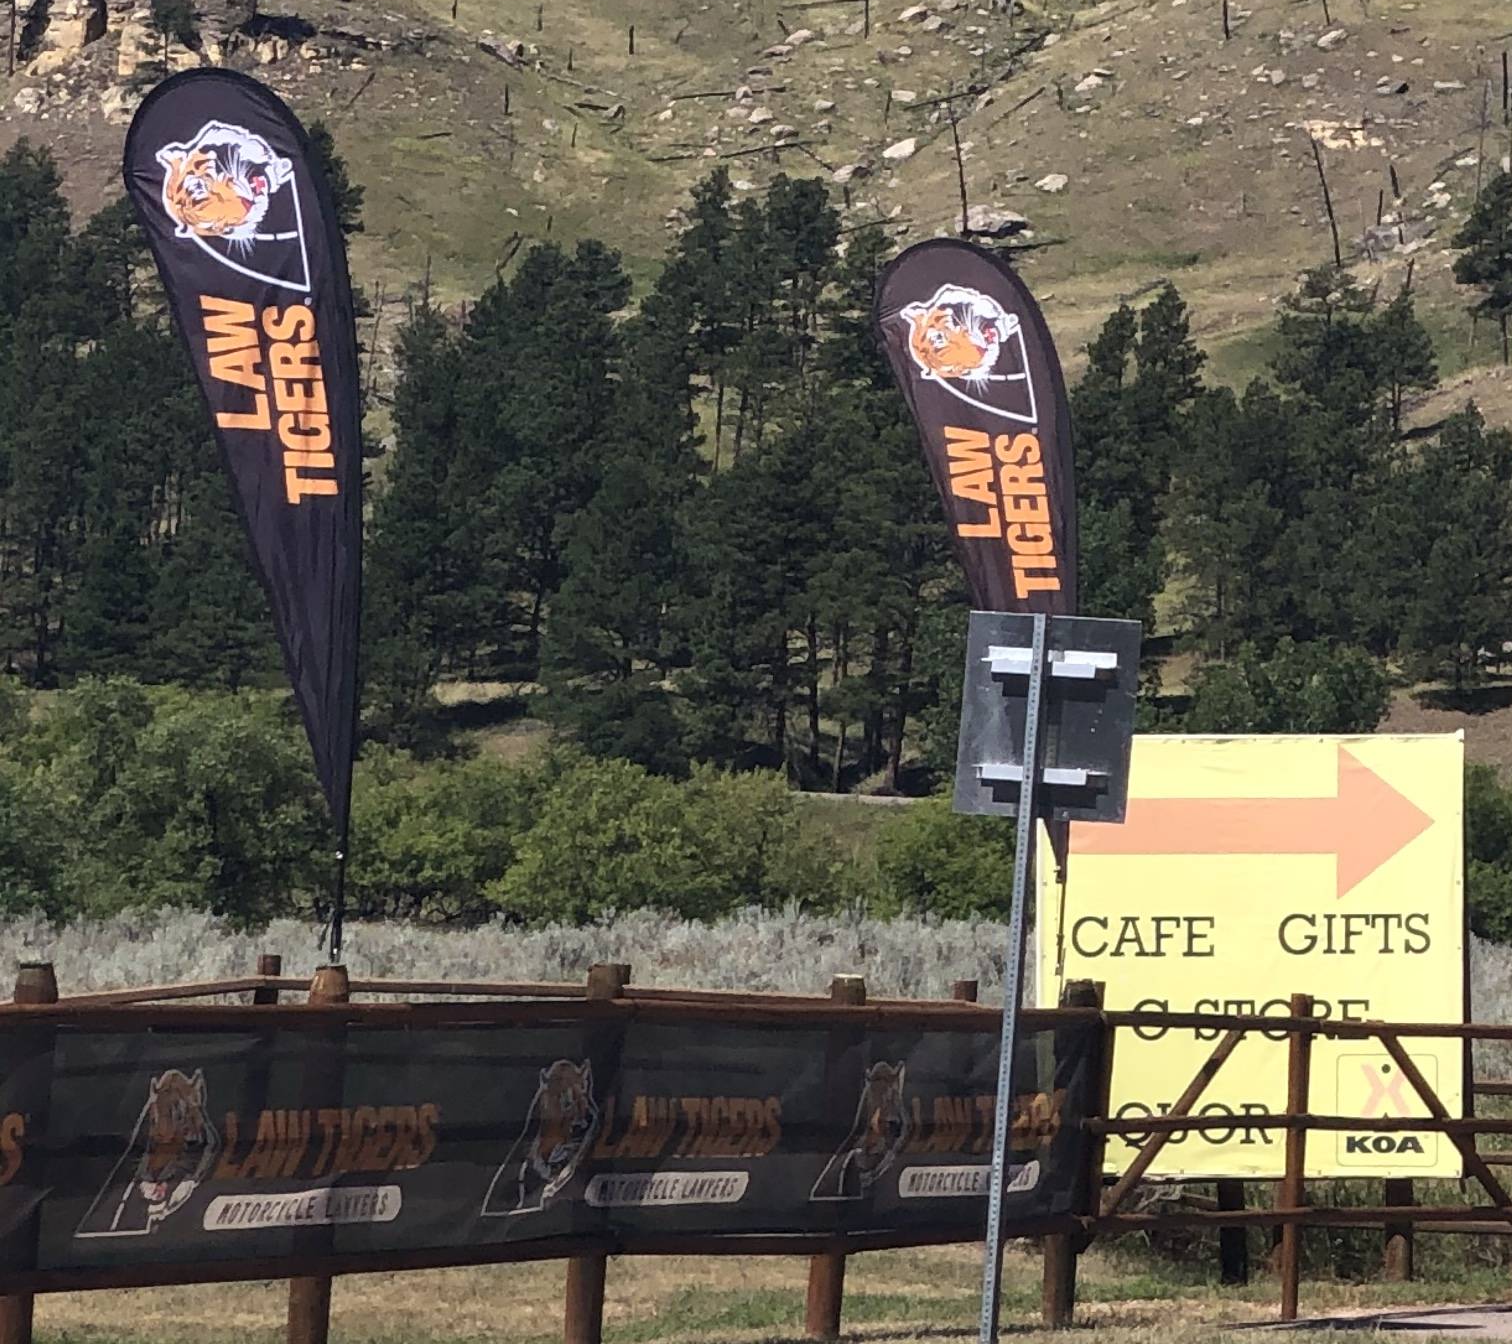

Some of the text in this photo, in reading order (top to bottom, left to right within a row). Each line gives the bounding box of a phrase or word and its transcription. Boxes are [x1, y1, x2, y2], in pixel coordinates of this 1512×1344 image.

[200, 294, 271, 431] LAW
[262, 303, 339, 505] TIGERS
[944, 425, 1002, 538] LAW
[994, 431, 1061, 599] TIGERS
[1071, 913, 1431, 958] CAFE GIFTS
[211, 1109, 311, 1179] LAW
[1346, 1136, 1425, 1153] KOA
[216, 1195, 315, 1224] MOTORCYCLE
